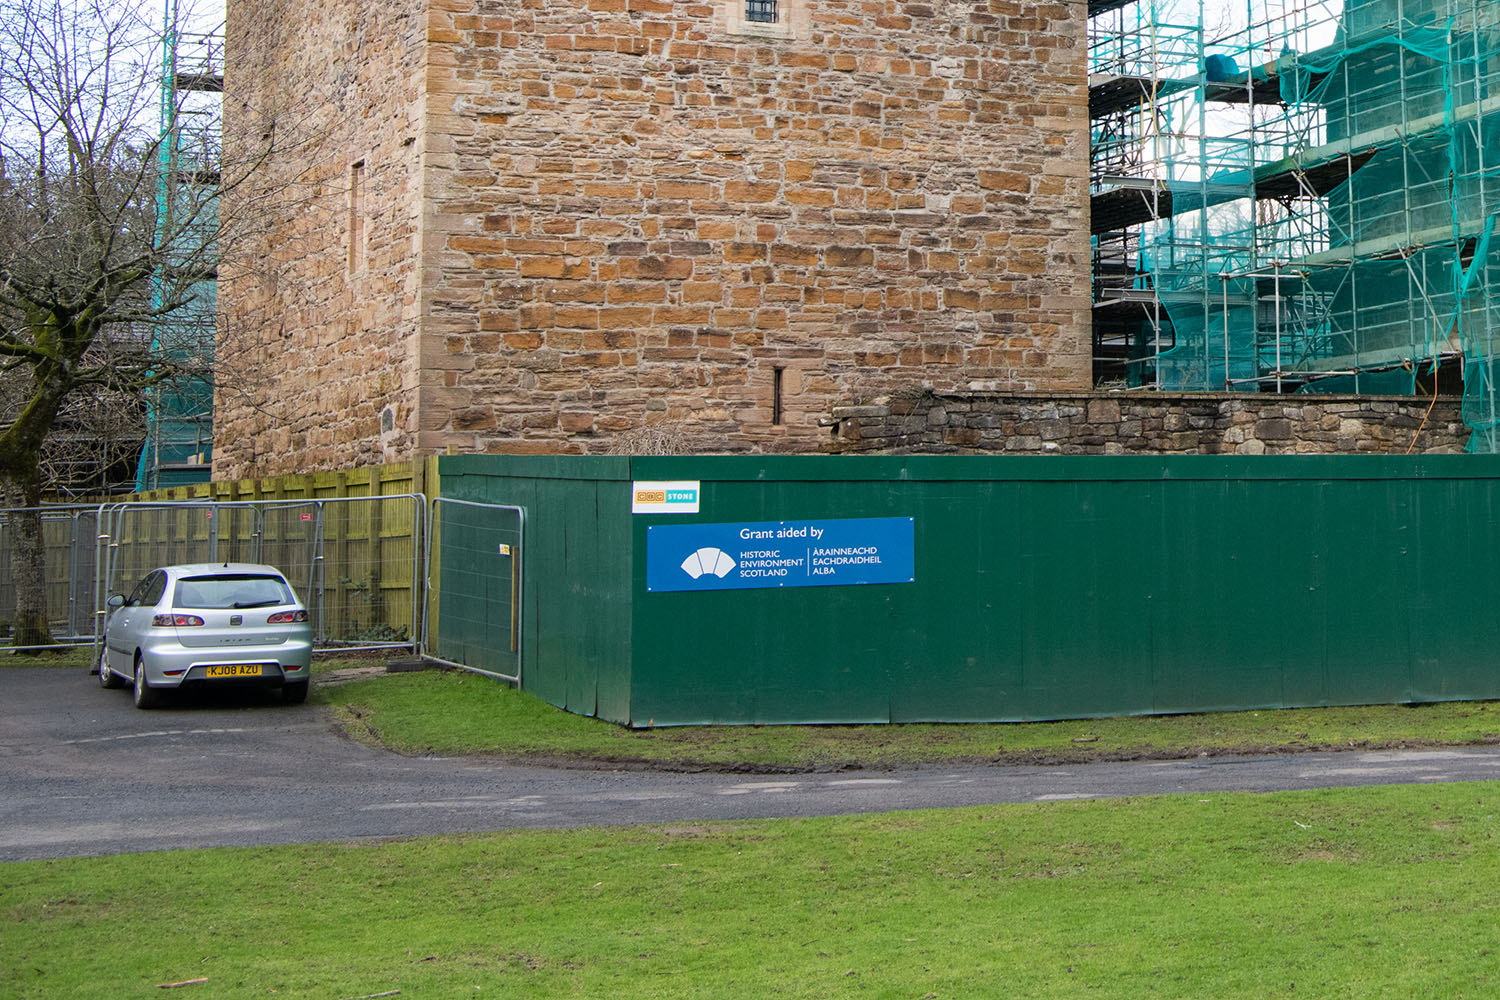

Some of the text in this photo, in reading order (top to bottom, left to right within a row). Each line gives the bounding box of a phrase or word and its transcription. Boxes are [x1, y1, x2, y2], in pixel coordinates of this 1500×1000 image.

[740, 527, 824, 541] Grant aided by
[740, 550, 780, 558] HISTORIC
[813, 546, 878, 556] ÀRAINNEACHD
[740, 559, 804, 568] ENVIRONMENT
[813, 556, 882, 566] EACHDRAIDHEIL
[740, 568, 788, 577] SCOTLAND
[210, 665, 258, 675] KJ08 AZU
